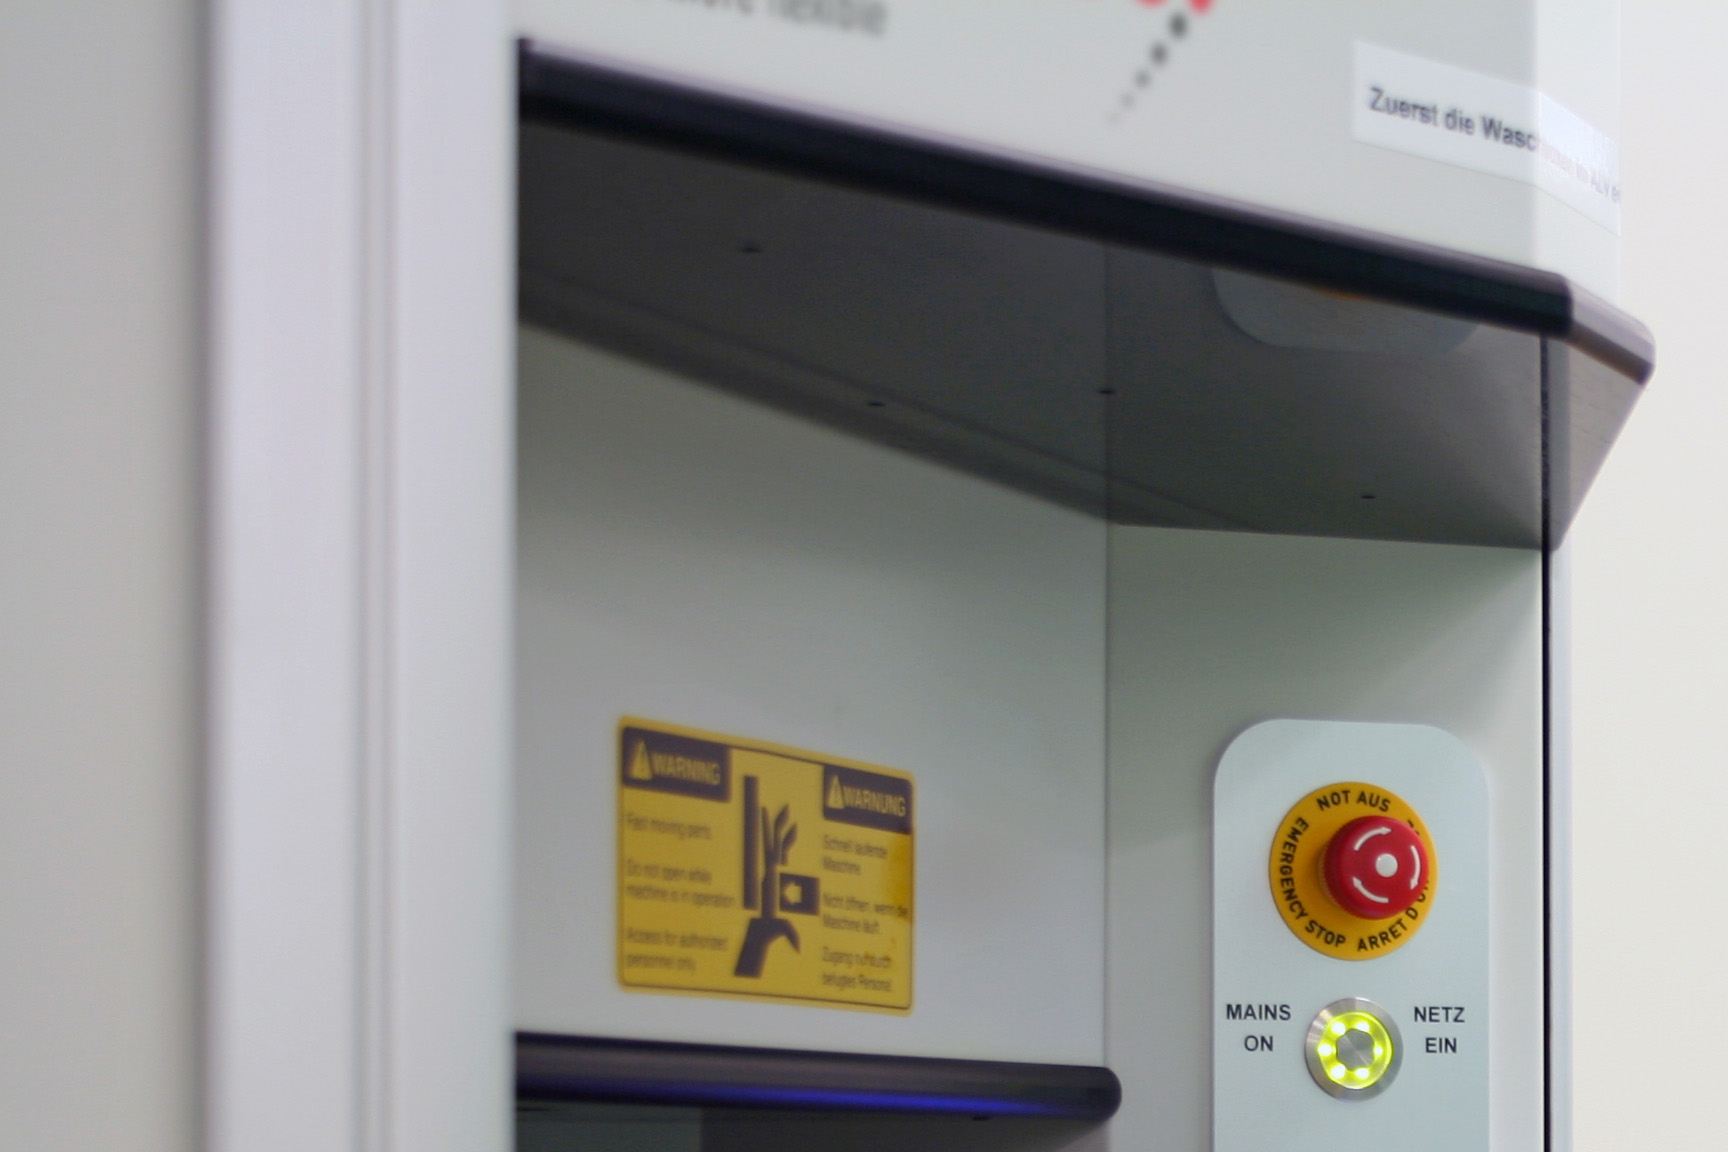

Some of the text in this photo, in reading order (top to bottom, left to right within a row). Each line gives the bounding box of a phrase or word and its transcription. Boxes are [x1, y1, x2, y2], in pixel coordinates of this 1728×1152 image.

[1370, 86, 1438, 127] Zuerst
[1445, 108, 1475, 136] die
[653, 753, 721, 786] WARNING
[843, 787, 907, 817] WARNUNG
[1317, 790, 1391, 812] NOT AUS
[1279, 817, 1346, 948] EMERGENCY STOP
[1357, 919, 1408, 952] ARRET
[1226, 1004, 1291, 1021] MAINS
[1414, 1006, 1465, 1023] NETZ
[1244, 1035, 1273, 1051] ON
[1425, 1038, 1457, 1053] EIN
